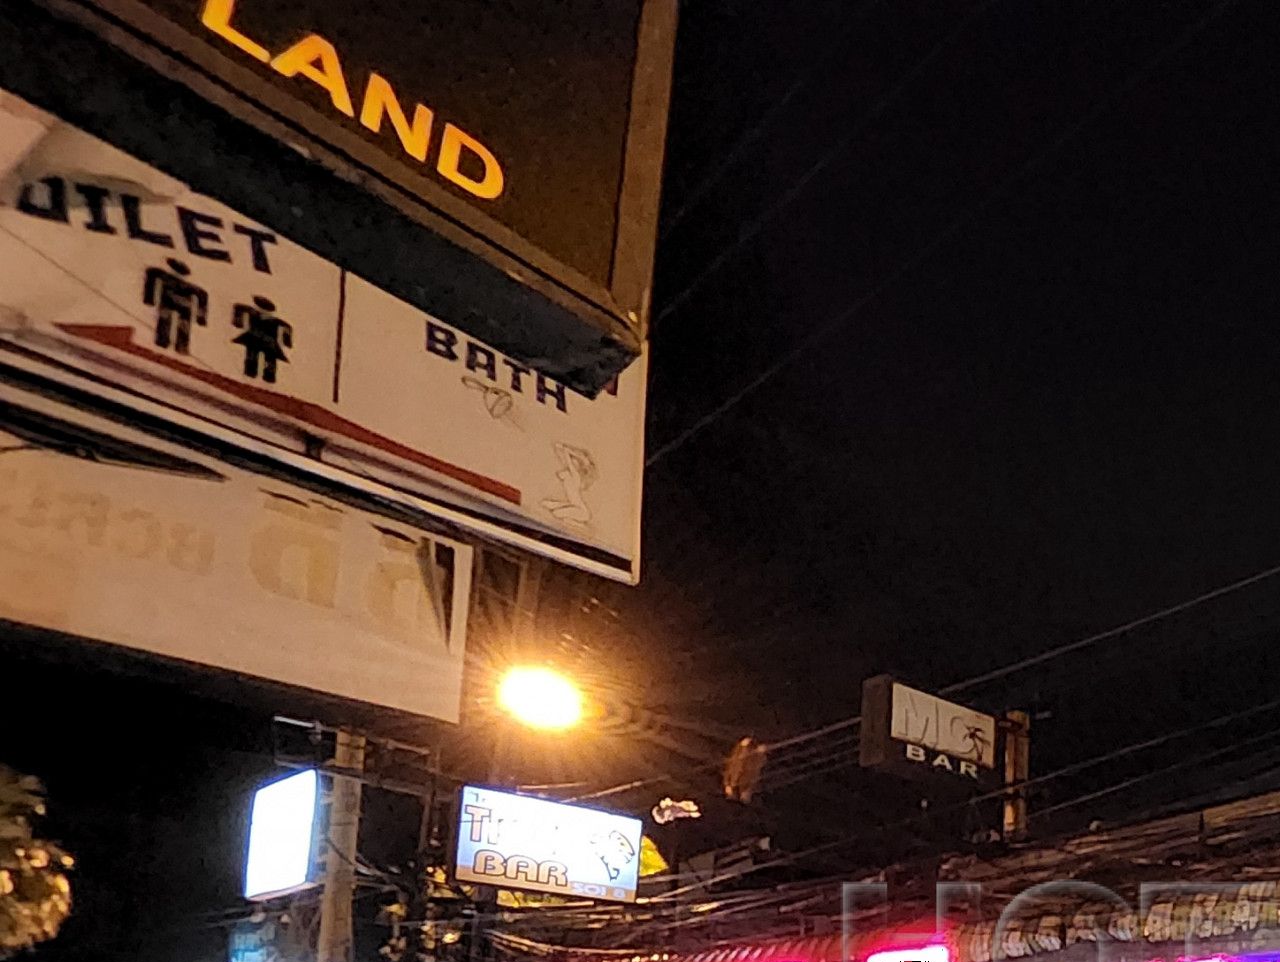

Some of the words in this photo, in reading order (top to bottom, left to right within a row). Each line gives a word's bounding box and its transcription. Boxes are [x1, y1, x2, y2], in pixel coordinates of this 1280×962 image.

[202, 0, 504, 199] LAND
[906, 743, 979, 779] BAR
[473, 849, 568, 887] BAR
